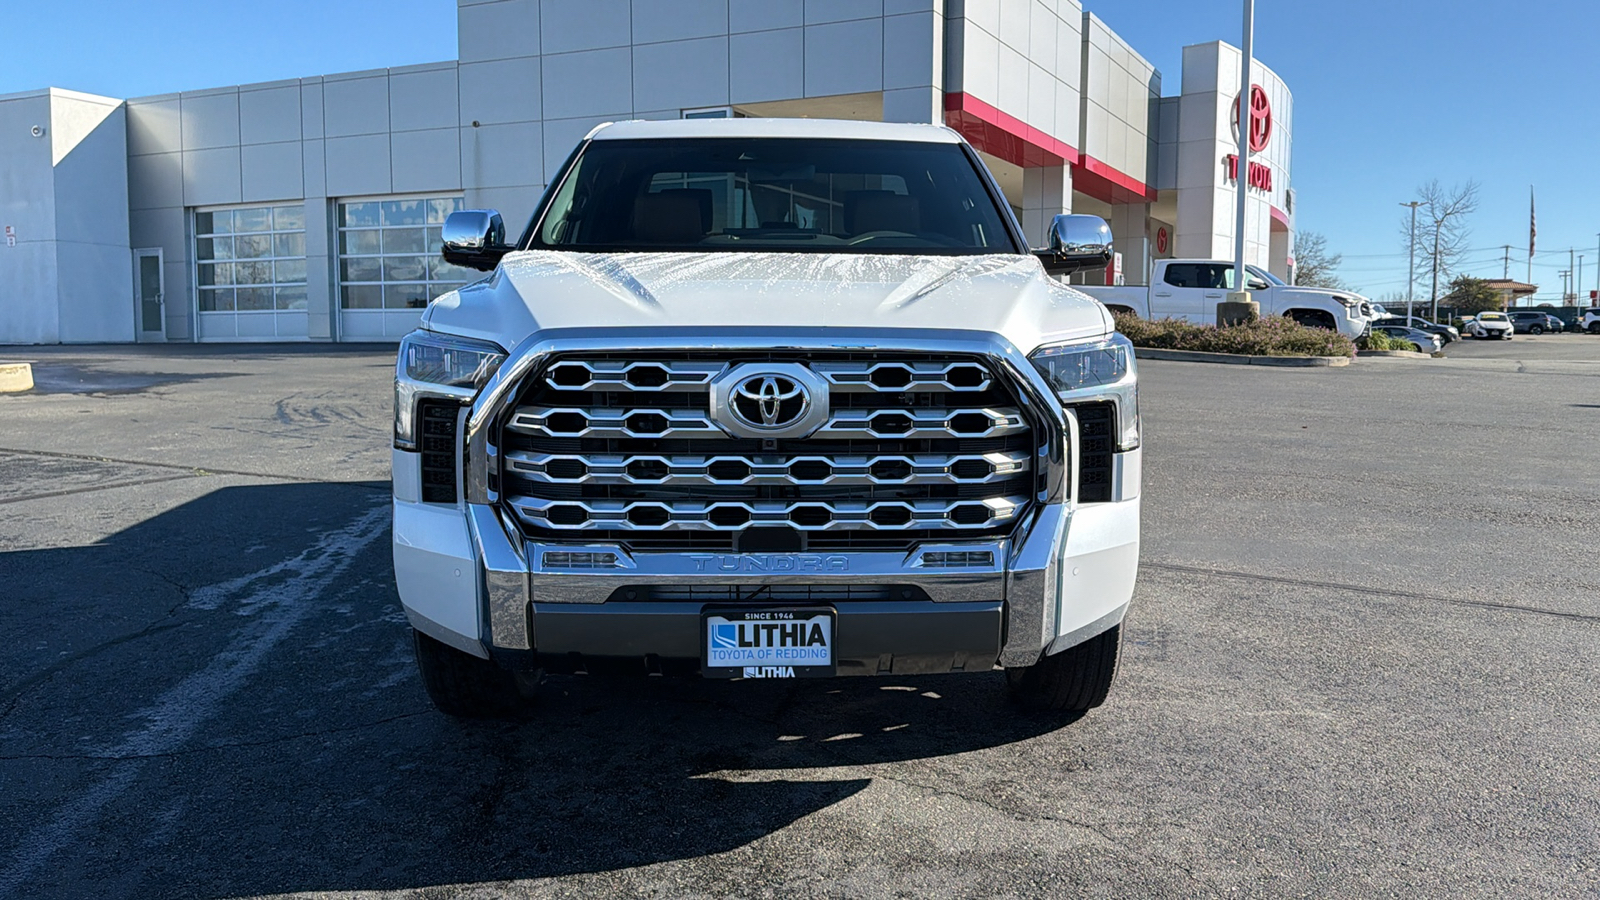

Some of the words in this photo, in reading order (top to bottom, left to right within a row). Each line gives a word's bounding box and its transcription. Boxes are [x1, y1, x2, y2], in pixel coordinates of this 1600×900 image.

[1227, 154, 1272, 192] TYOTA
[690, 555, 850, 571] TUNDRA
[774, 612, 794, 620] 1946
[738, 623, 827, 648] LITHIA
[711, 649, 755, 660] TOYOTA
[757, 649, 772, 659] OF
[775, 648, 828, 659] REDDING
[755, 666, 796, 678] LITHIA
